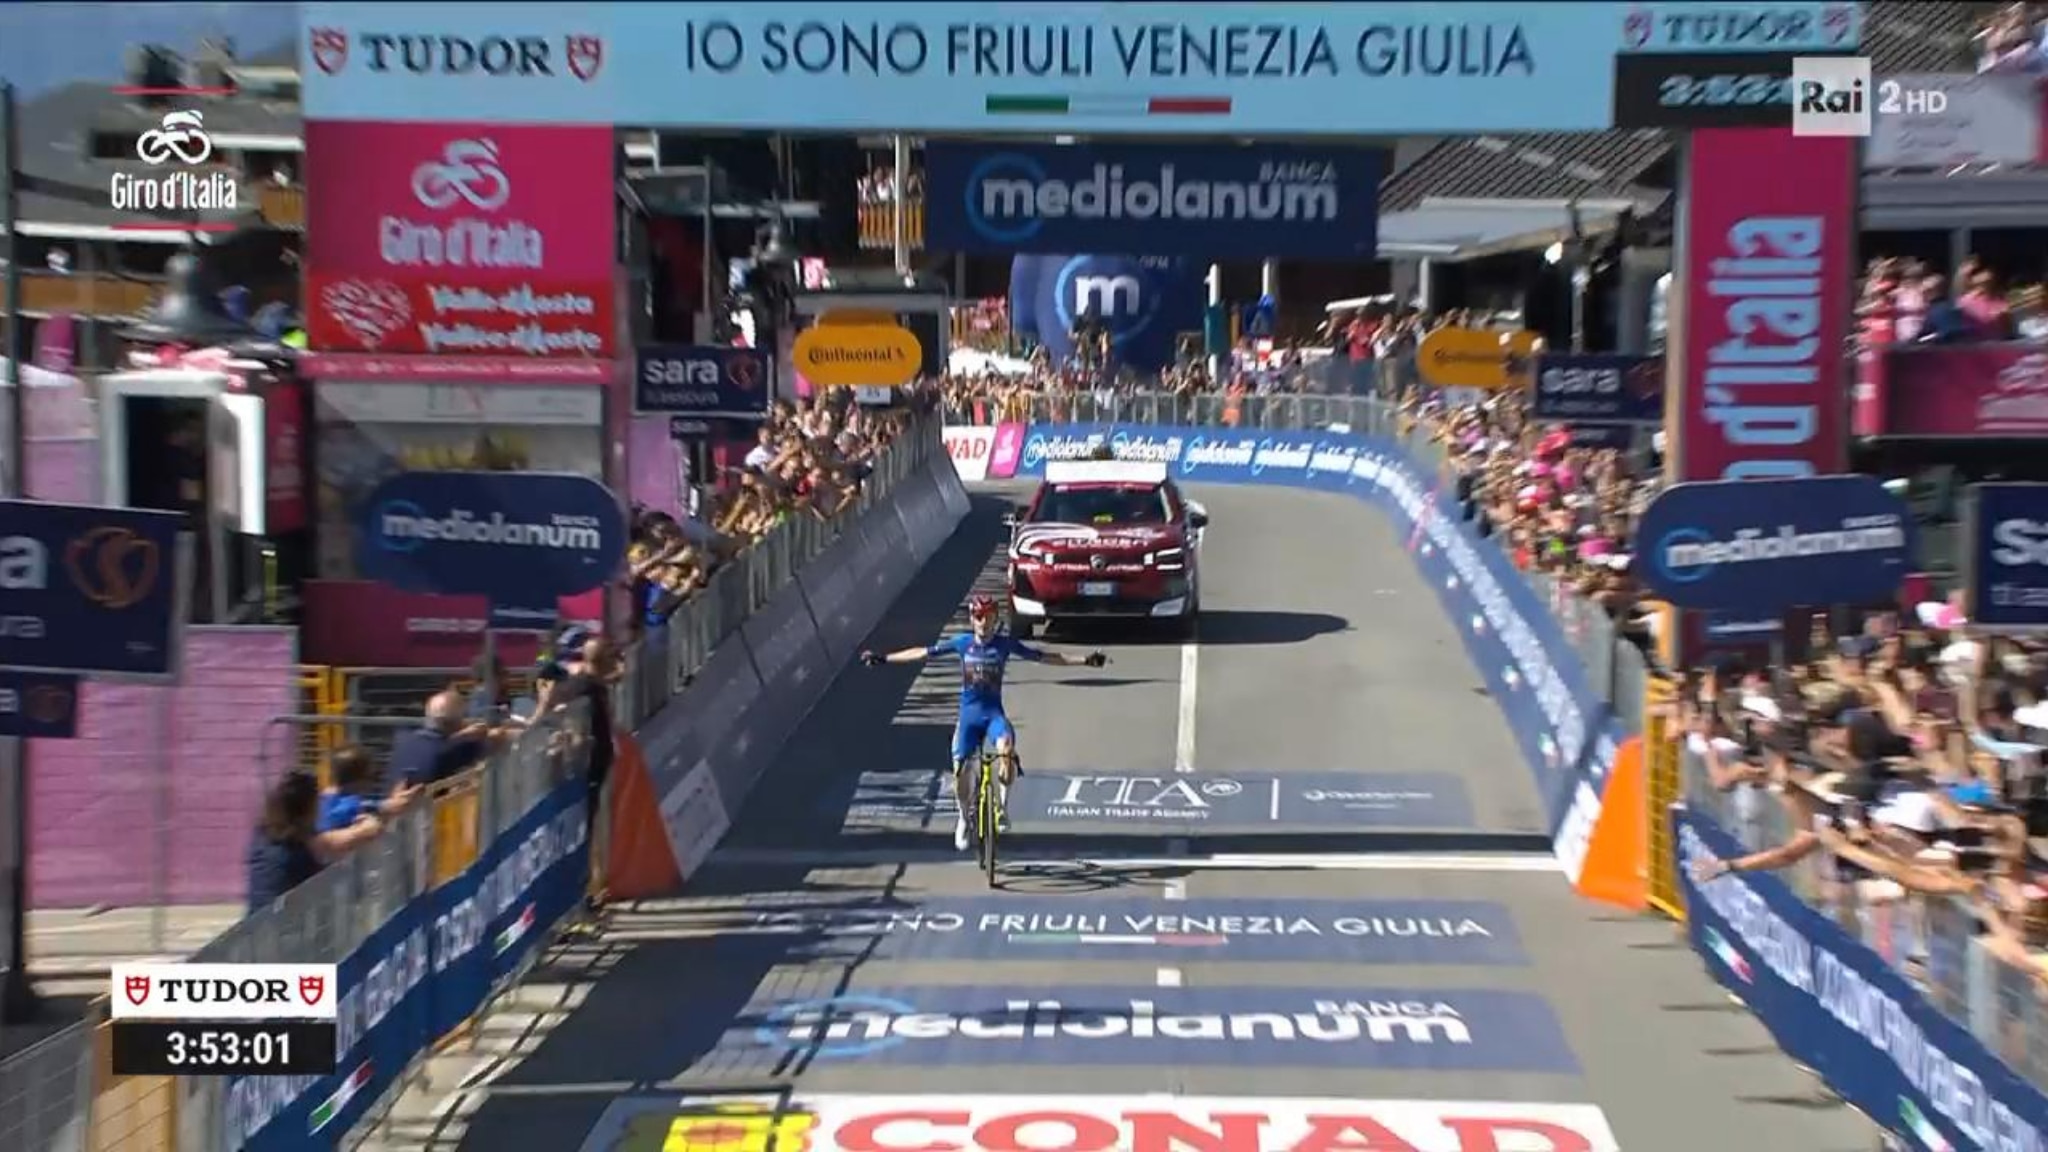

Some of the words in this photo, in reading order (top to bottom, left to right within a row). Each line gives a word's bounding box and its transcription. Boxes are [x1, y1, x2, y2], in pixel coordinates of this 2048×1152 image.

[362, 34, 552, 77] TUDOR
[686, 21, 744, 74] IO
[761, 21, 928, 74] SONO
[948, 25, 1094, 76] FRIULI
[1112, 25, 1338, 77] VENEZIA
[1356, 25, 1536, 78] GIULIA
[1258, 162, 1337, 183] BANCA
[982, 164, 1338, 220] mediolanum
[645, 358, 719, 384] sara
[382, 510, 600, 549] mediolanum
[1052, 776, 1211, 807] ITA
[979, 913, 1106, 932] FRIULI
[1124, 915, 1322, 936] VENEZIA
[1333, 917, 1493, 937] GIULIA
[1312, 1000, 1464, 1017] BANCA
[833, 1110, 1592, 1152] CONAD
